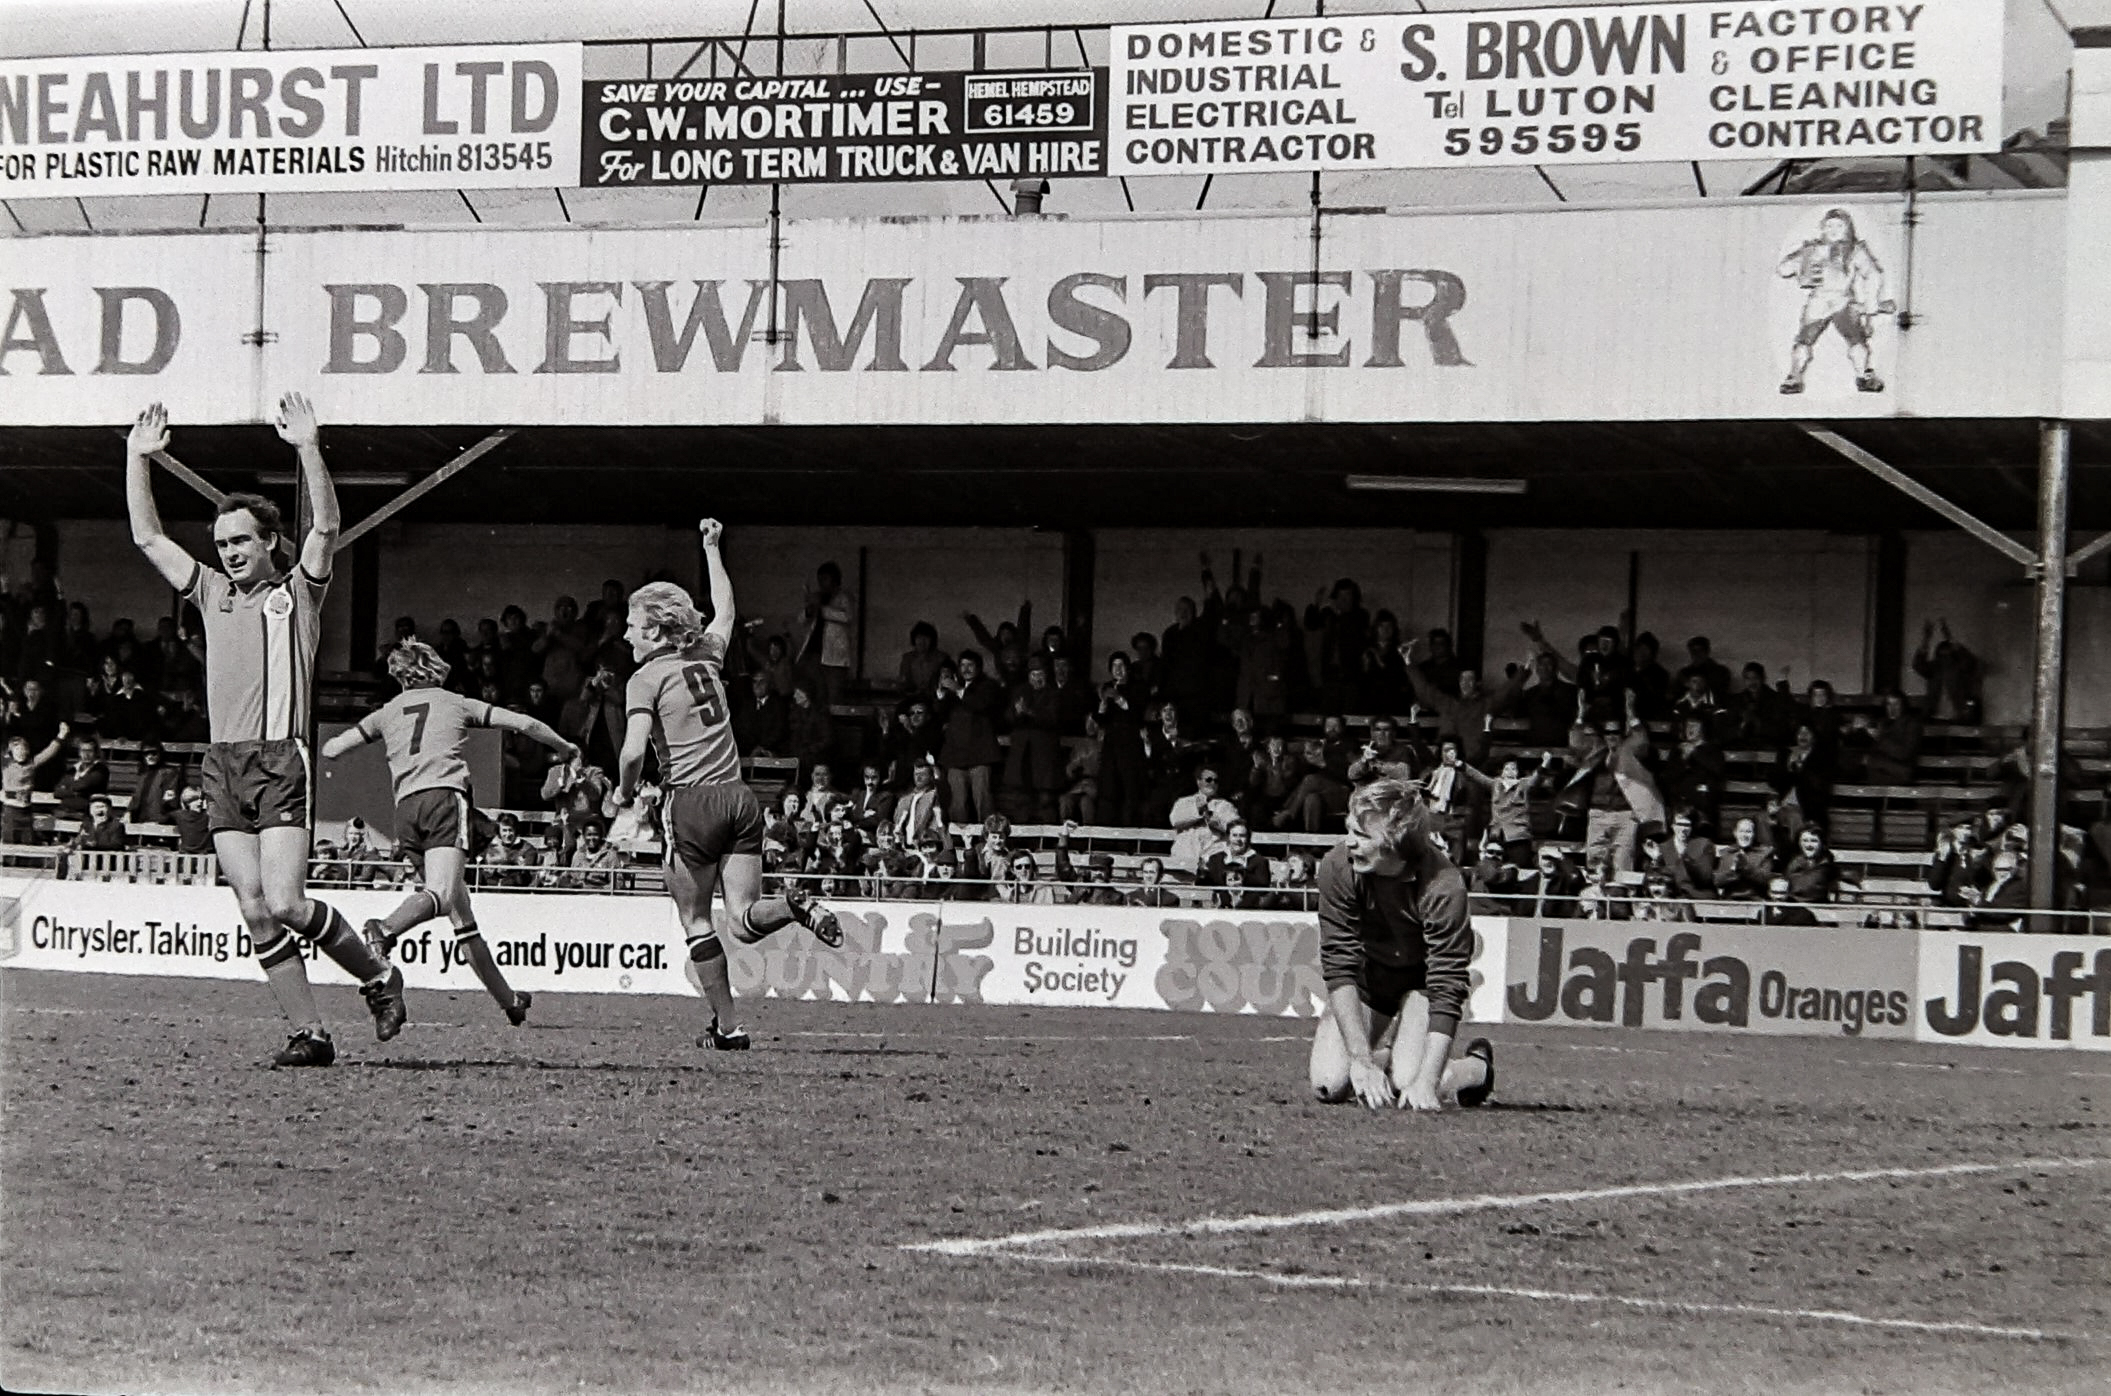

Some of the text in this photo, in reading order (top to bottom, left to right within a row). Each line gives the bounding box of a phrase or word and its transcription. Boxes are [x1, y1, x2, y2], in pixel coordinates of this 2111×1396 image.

[1710, 4, 1924, 39] FACTORY
[1127, 27, 1376, 60] DOMESTIC &
[1400, 14, 1686, 83] S. BROWN
[1710, 41, 1915, 76] & OFFICE
[600, 83, 659, 104] SAVE
[662, 77, 727, 103] YOUR
[734, 75, 831, 101] CAPITAL
[967, 79, 1091, 99] HEMEL HEMPSTEAD
[1126, 63, 1341, 96] INDUSTRIAL
[1709, 78, 1937, 113] CLEANING
[422, 59, 559, 136] LTD
[984, 102, 1075, 126] 61459
[1125, 98, 1357, 131] ELECTRICAL
[1423, 84, 1655, 119] Tel LUTON
[1125, 132, 1376, 165] CONTRACTOR
[1443, 122, 1642, 157] 595595
[1708, 114, 1983, 149] CONTRACTOR
[45, 150, 140, 180] PLASTIC
[147, 148, 202, 177] RAW
[213, 145, 365, 176] MATERIALS
[376, 144, 452, 173] Hitchin
[456, 141, 553, 172] 813545
[598, 140, 1101, 184] For LONG TERM TRUCK & VAN HIRE
[0, 268, 1476, 376] AD BREWMASTER
[682, 662, 724, 727] 9
[402, 702, 430, 756] 7
[144, 921, 229, 963] Taking
[401, 931, 432, 964] of
[438, 937, 472, 975] yo
[496, 932, 547, 967] and
[554, 941, 615, 975] your
[619, 943, 668, 970] car.
[1014, 926, 1138, 968] Building
[1023, 962, 1126, 1000] Society
[1508, 926, 1750, 1028] Jaffa
[1759, 969, 1908, 1036] Oranges
